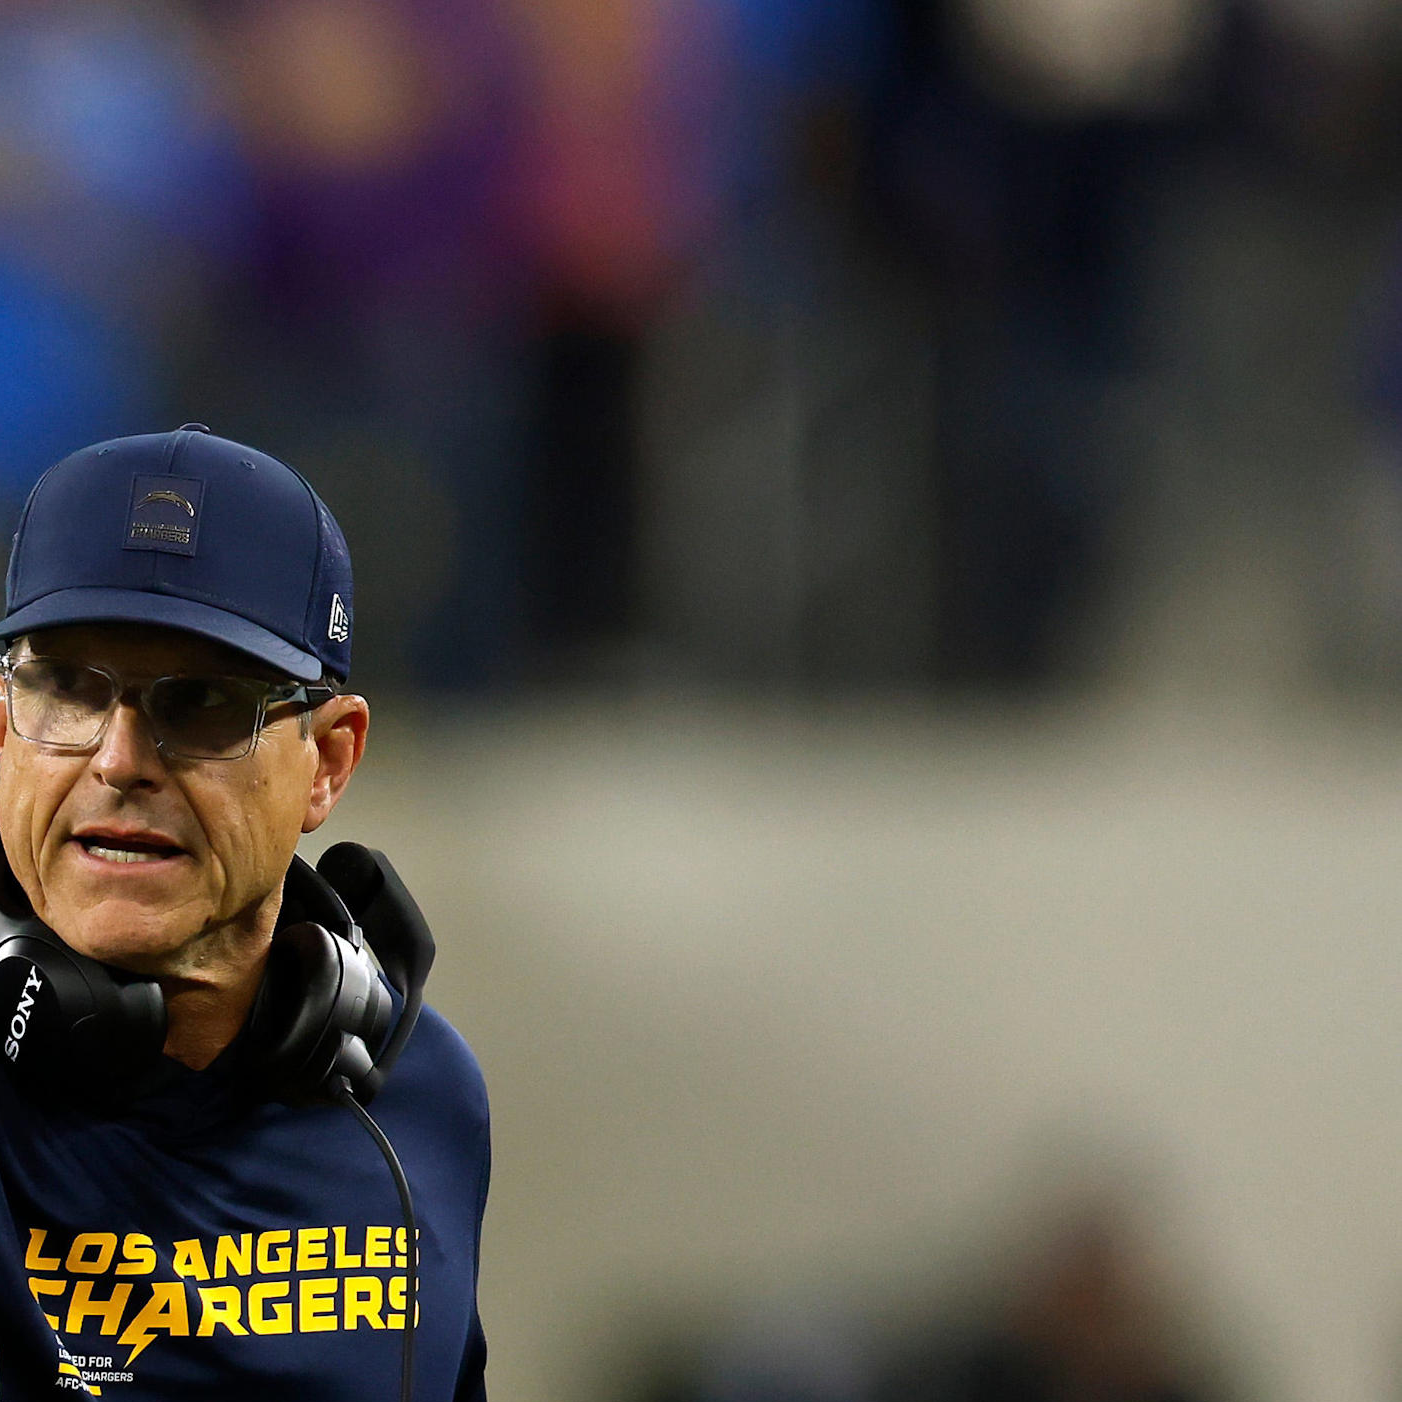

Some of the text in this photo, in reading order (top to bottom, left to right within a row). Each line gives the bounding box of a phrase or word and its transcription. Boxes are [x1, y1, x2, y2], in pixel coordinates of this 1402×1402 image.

[4, 965, 42, 1062] SONY
[25, 1226, 420, 1281] LOS ANGELES
[81, 1371, 134, 1382] CHARGERS
[89, 1356, 113, 1368] FOR
